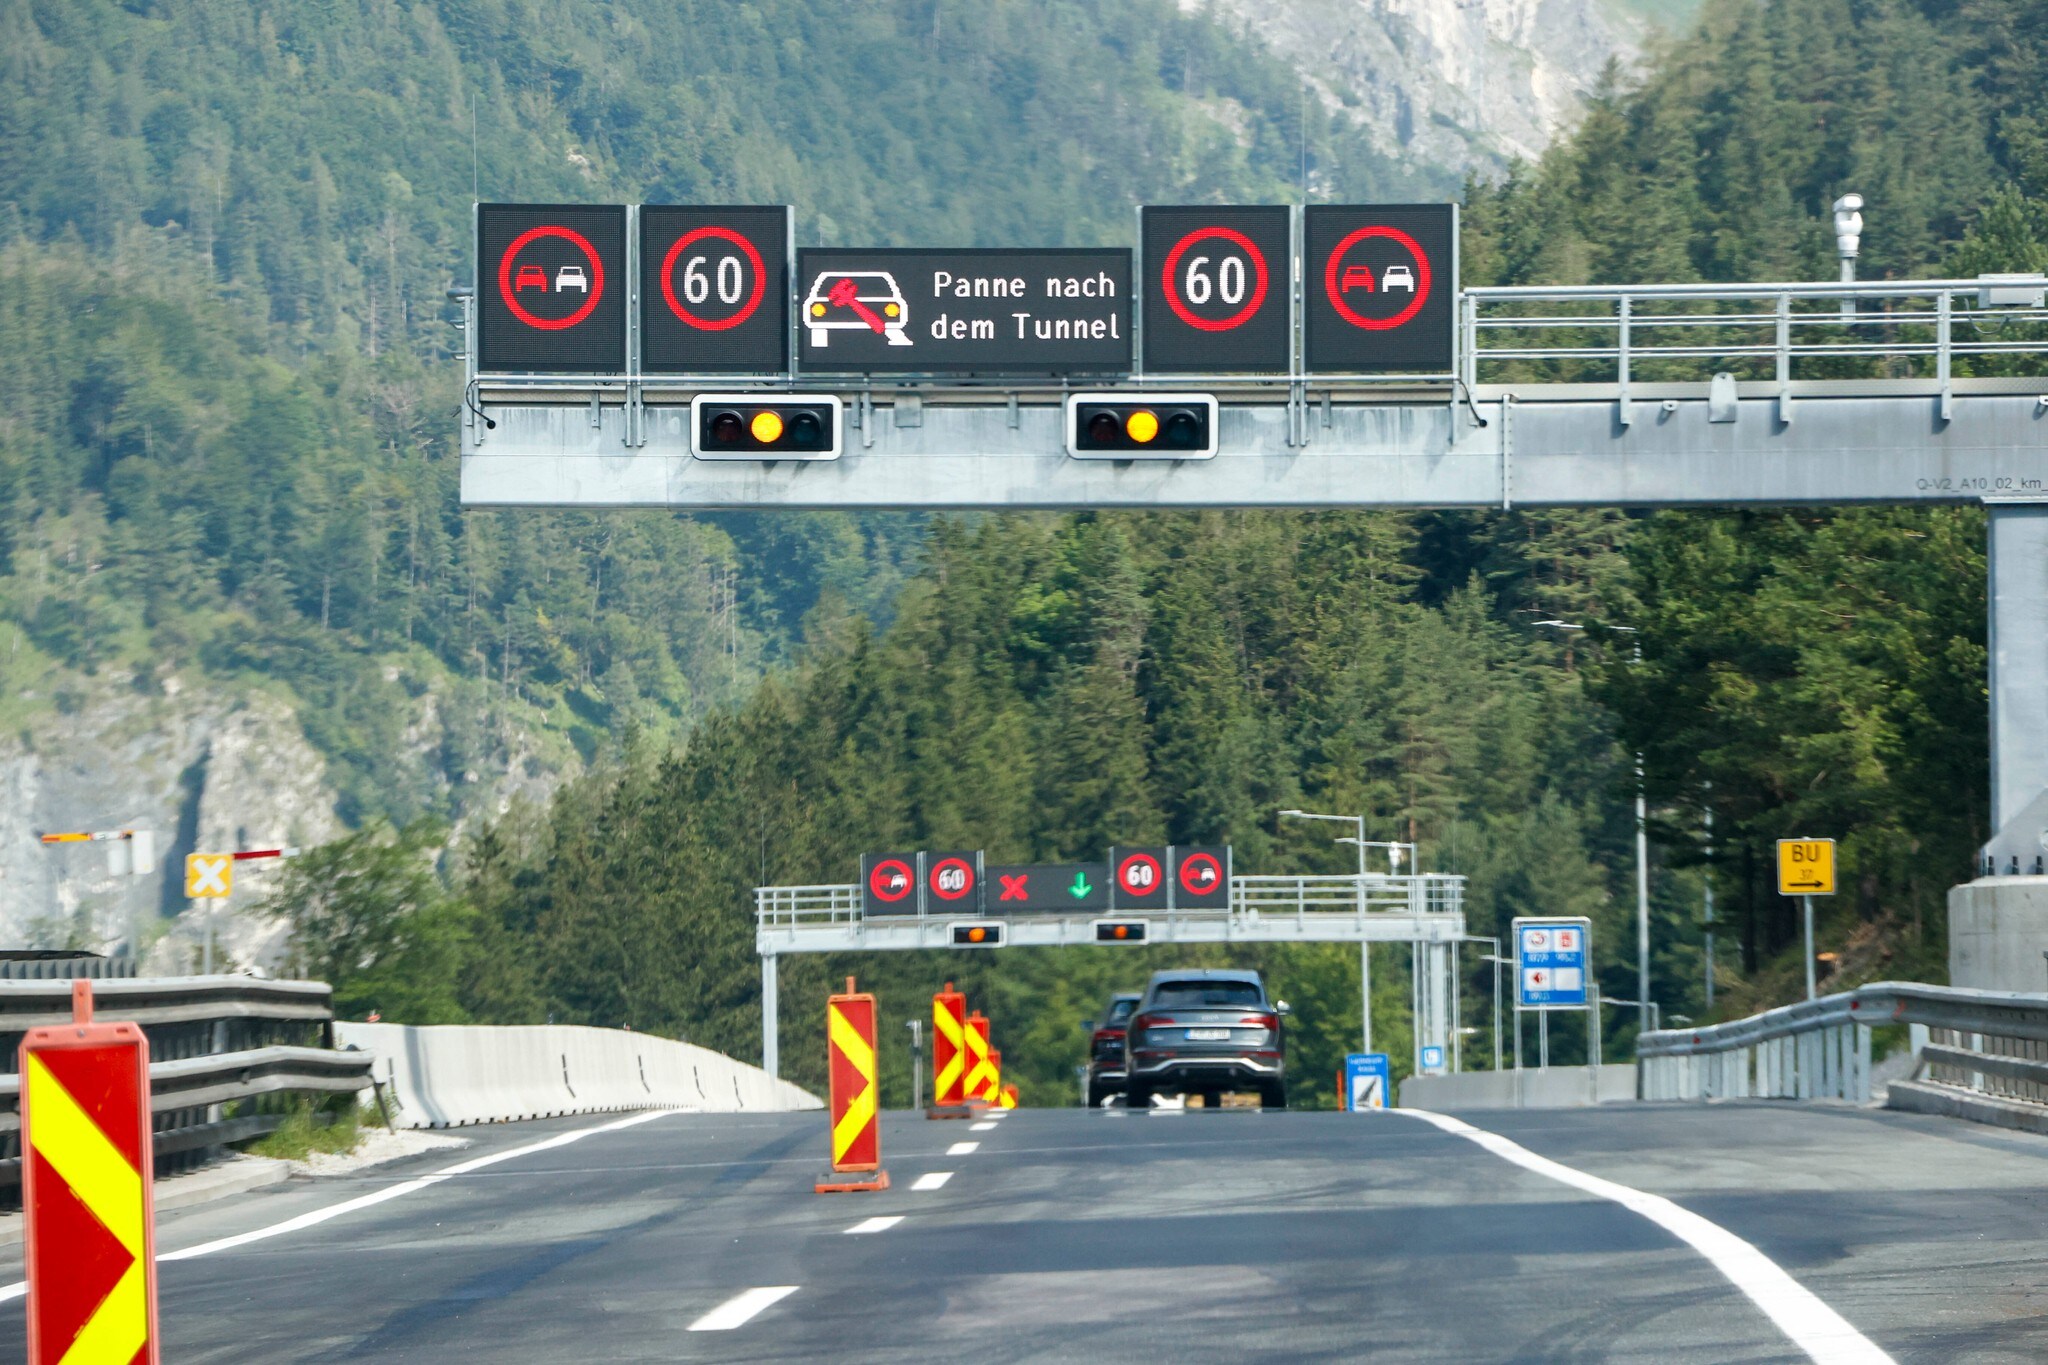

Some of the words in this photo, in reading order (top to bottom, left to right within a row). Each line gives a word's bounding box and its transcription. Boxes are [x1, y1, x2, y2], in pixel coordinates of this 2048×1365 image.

[683, 255, 743, 304] 60
[933, 271, 1026, 299] Panne
[1046, 271, 1115, 299] nach
[1185, 256, 1246, 305] 60
[930, 313, 995, 341] dem
[1011, 312, 1121, 341] Tunnel
[1792, 844, 1820, 862] BU
[938, 868, 966, 890] 60
[1126, 864, 1153, 886] 60
